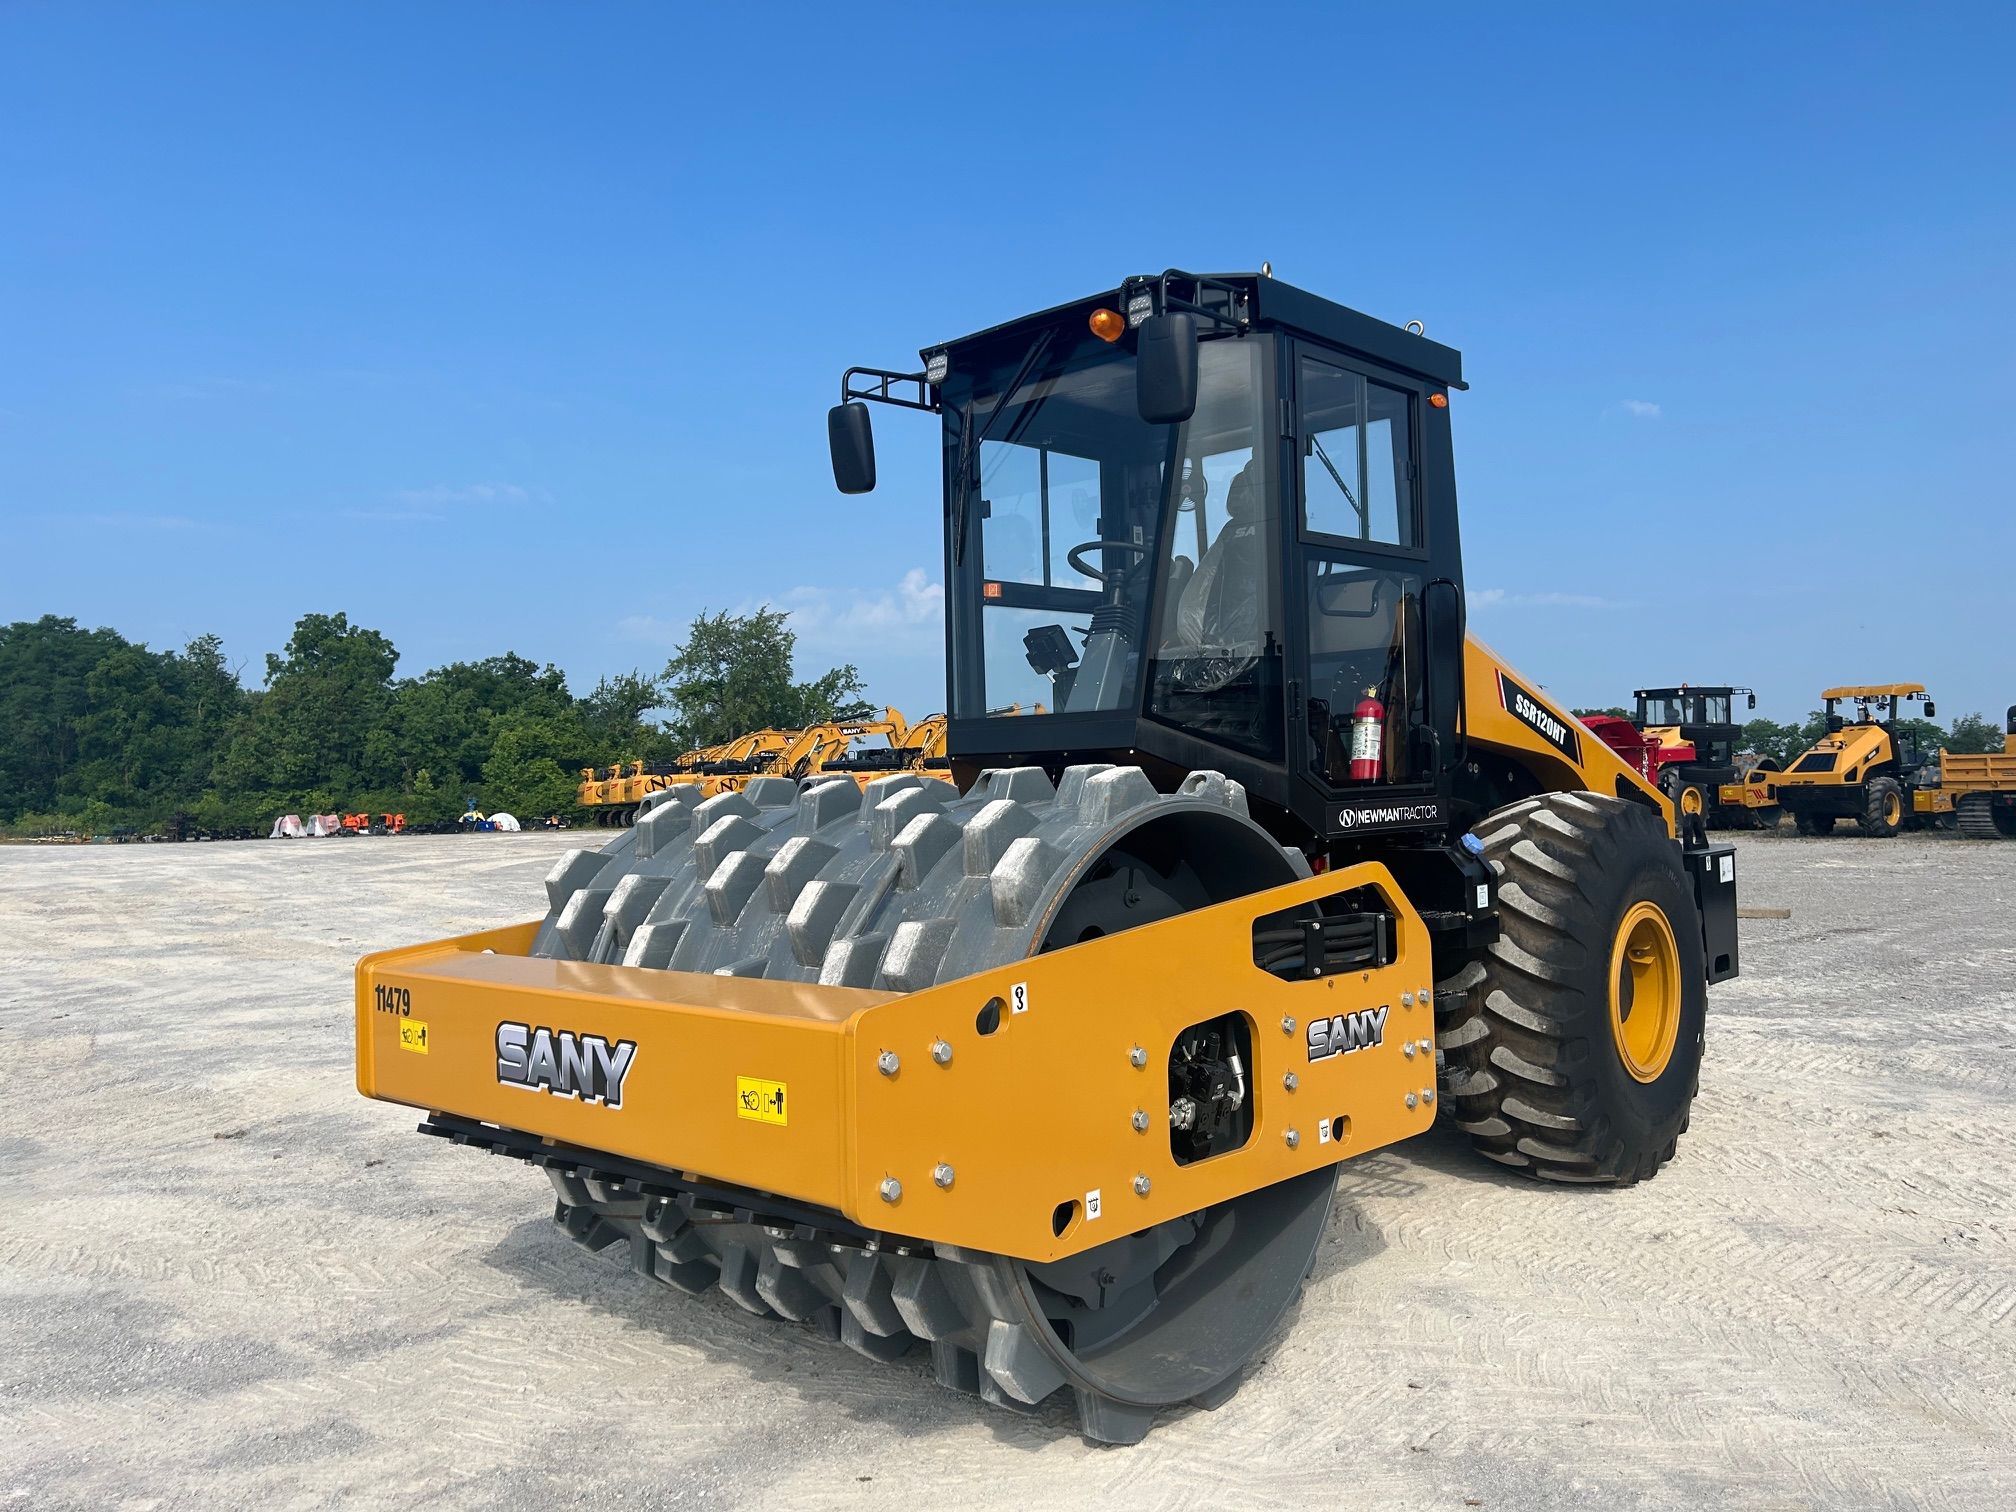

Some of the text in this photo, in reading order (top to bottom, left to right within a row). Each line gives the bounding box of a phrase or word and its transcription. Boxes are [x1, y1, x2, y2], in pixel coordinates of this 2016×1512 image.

[1515, 693, 1567, 745] SSR120HT
[375, 984, 411, 1017] 11479
[1307, 1005, 1390, 1063] SANY
[496, 1020, 638, 1110] SANY
